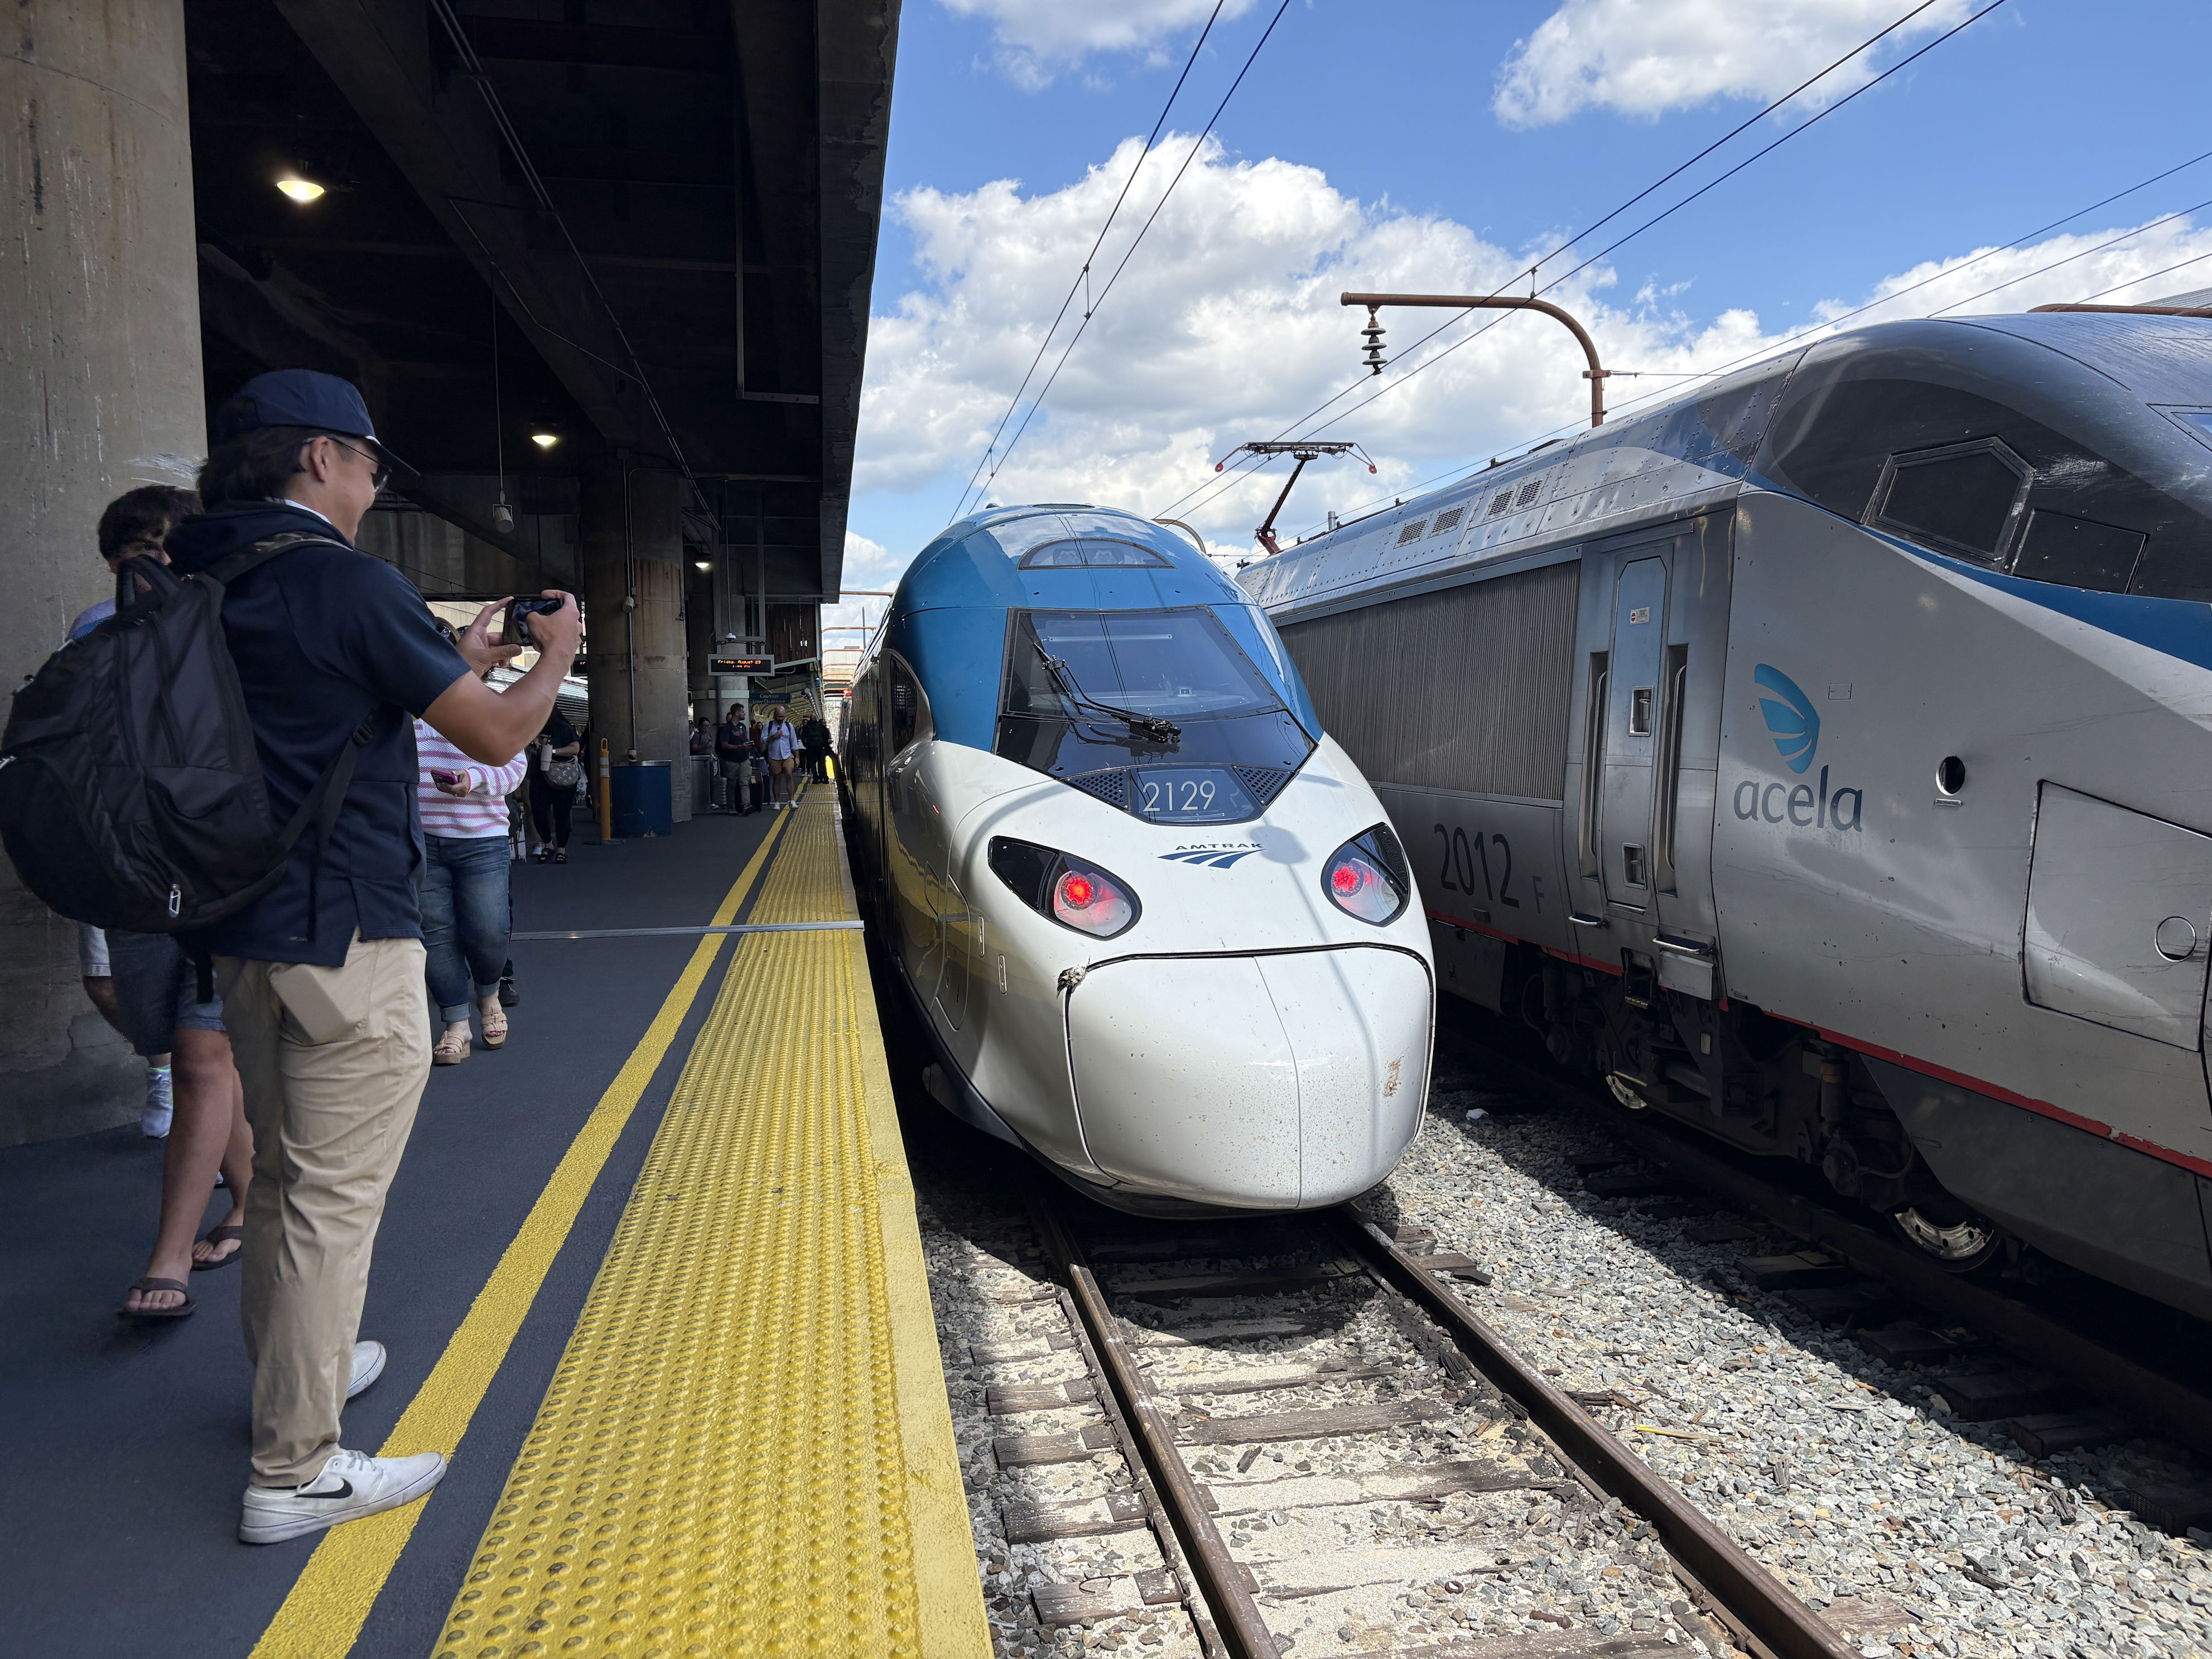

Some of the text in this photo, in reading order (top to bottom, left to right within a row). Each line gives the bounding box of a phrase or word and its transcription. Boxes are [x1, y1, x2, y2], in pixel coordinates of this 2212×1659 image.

[1143, 780, 1216, 812] 2129
[1733, 764, 1863, 833] acela
[1175, 842, 1263, 851] AMTRAK
[1434, 823, 1545, 914] 2012 F
